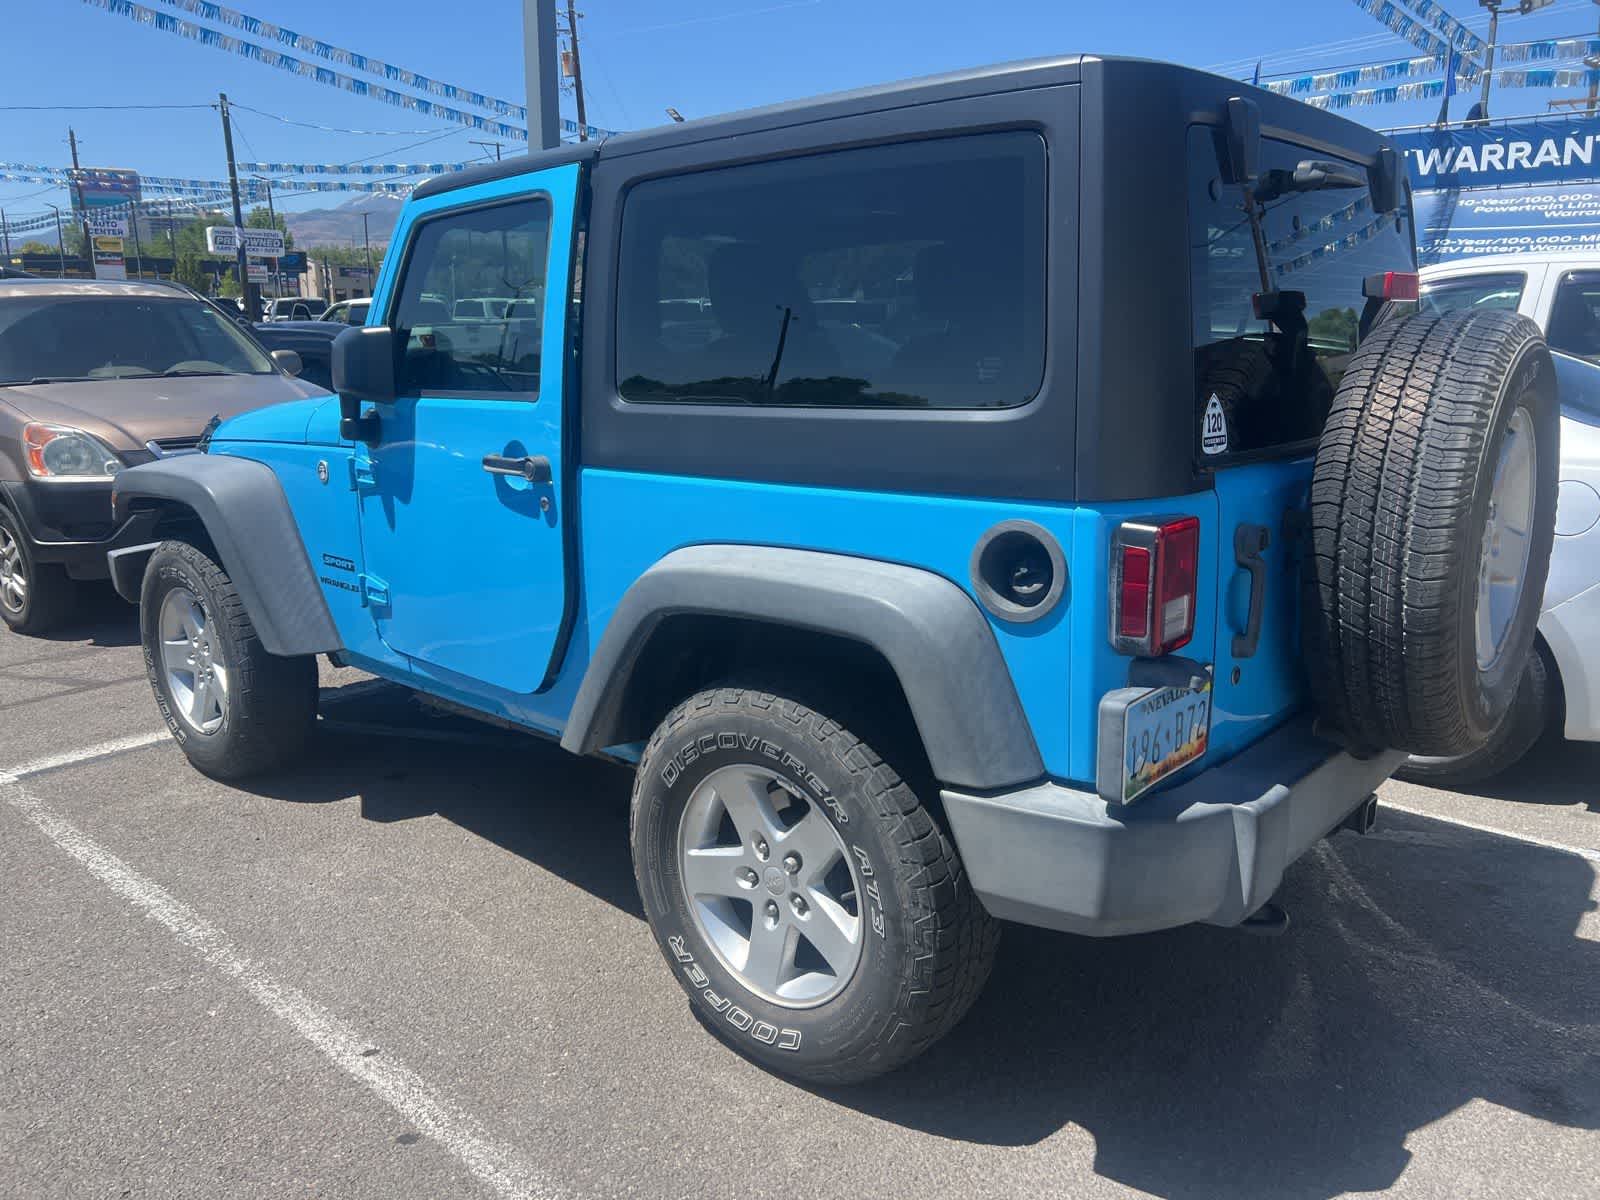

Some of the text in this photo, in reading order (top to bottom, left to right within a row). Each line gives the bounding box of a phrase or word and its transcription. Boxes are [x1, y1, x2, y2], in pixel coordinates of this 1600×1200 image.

[1411, 135, 1600, 176] WARRAN
[1473, 203, 1564, 214] Powertrain
[88, 228, 124, 236] CENTER
[1462, 245, 1526, 254] Battery
[1207, 413, 1222, 433] 120
[323, 555, 353, 570] SPORT
[661, 732, 886, 940] DISCOVERER AT3
[668, 935, 802, 1051] COOPER
